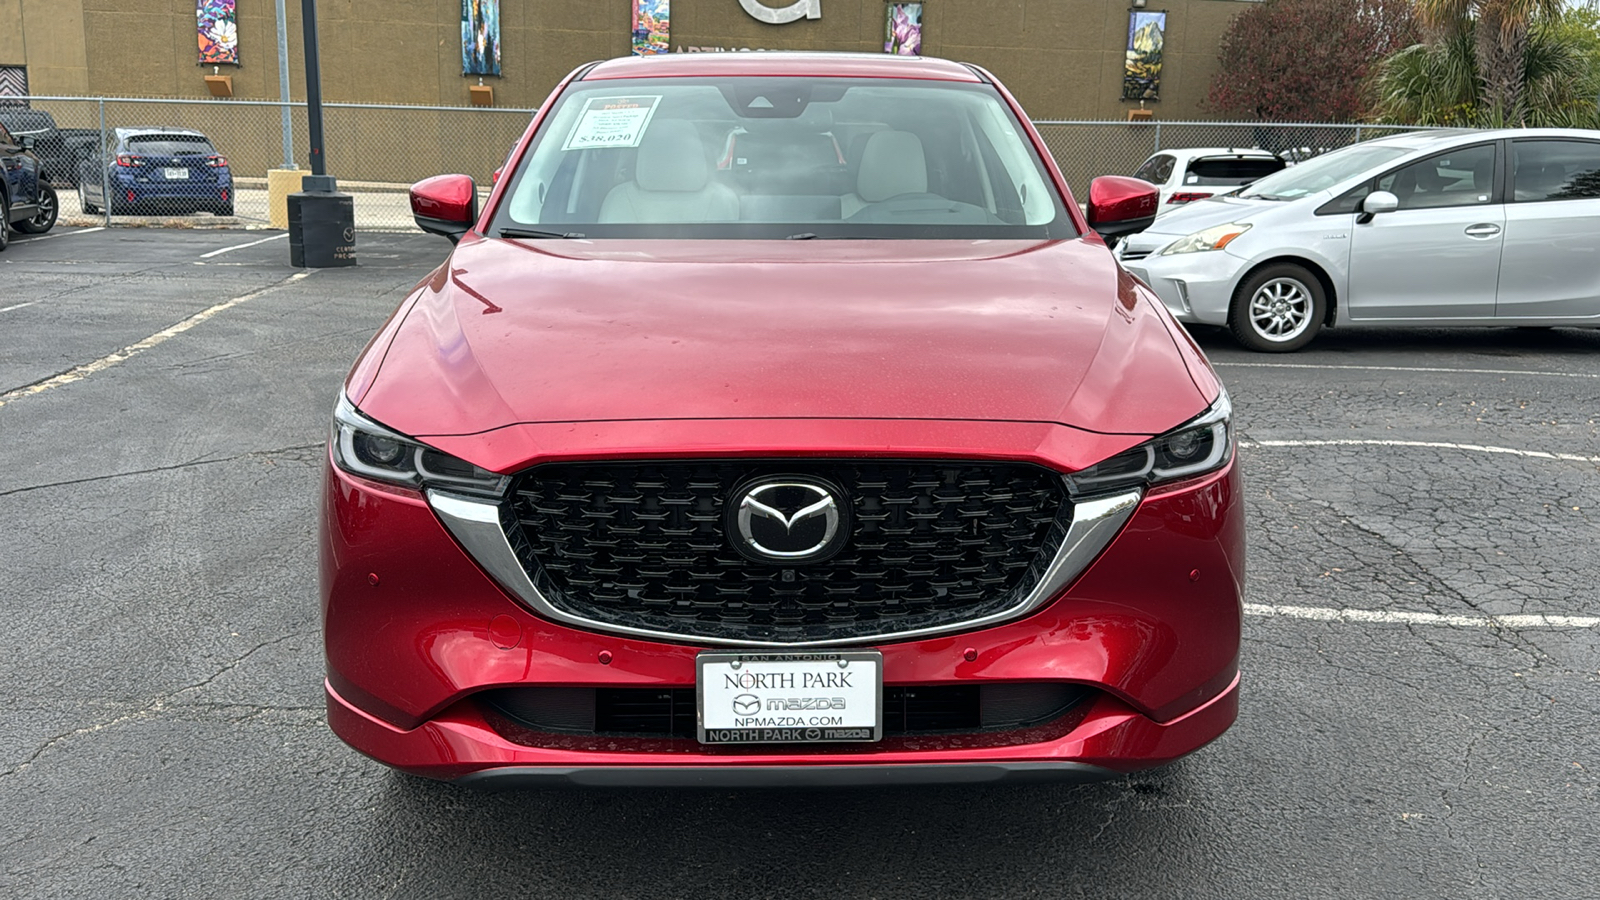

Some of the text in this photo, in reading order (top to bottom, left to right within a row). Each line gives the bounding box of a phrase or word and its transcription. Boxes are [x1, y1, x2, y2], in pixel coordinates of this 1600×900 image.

[579, 133, 632, 142] $38,020
[724, 672, 853, 689] NORTH PARK
[766, 697, 846, 711] mazda
[734, 716, 843, 727] NPMAZDA.COM
[709, 729, 870, 741] NORTH PARK mazda
